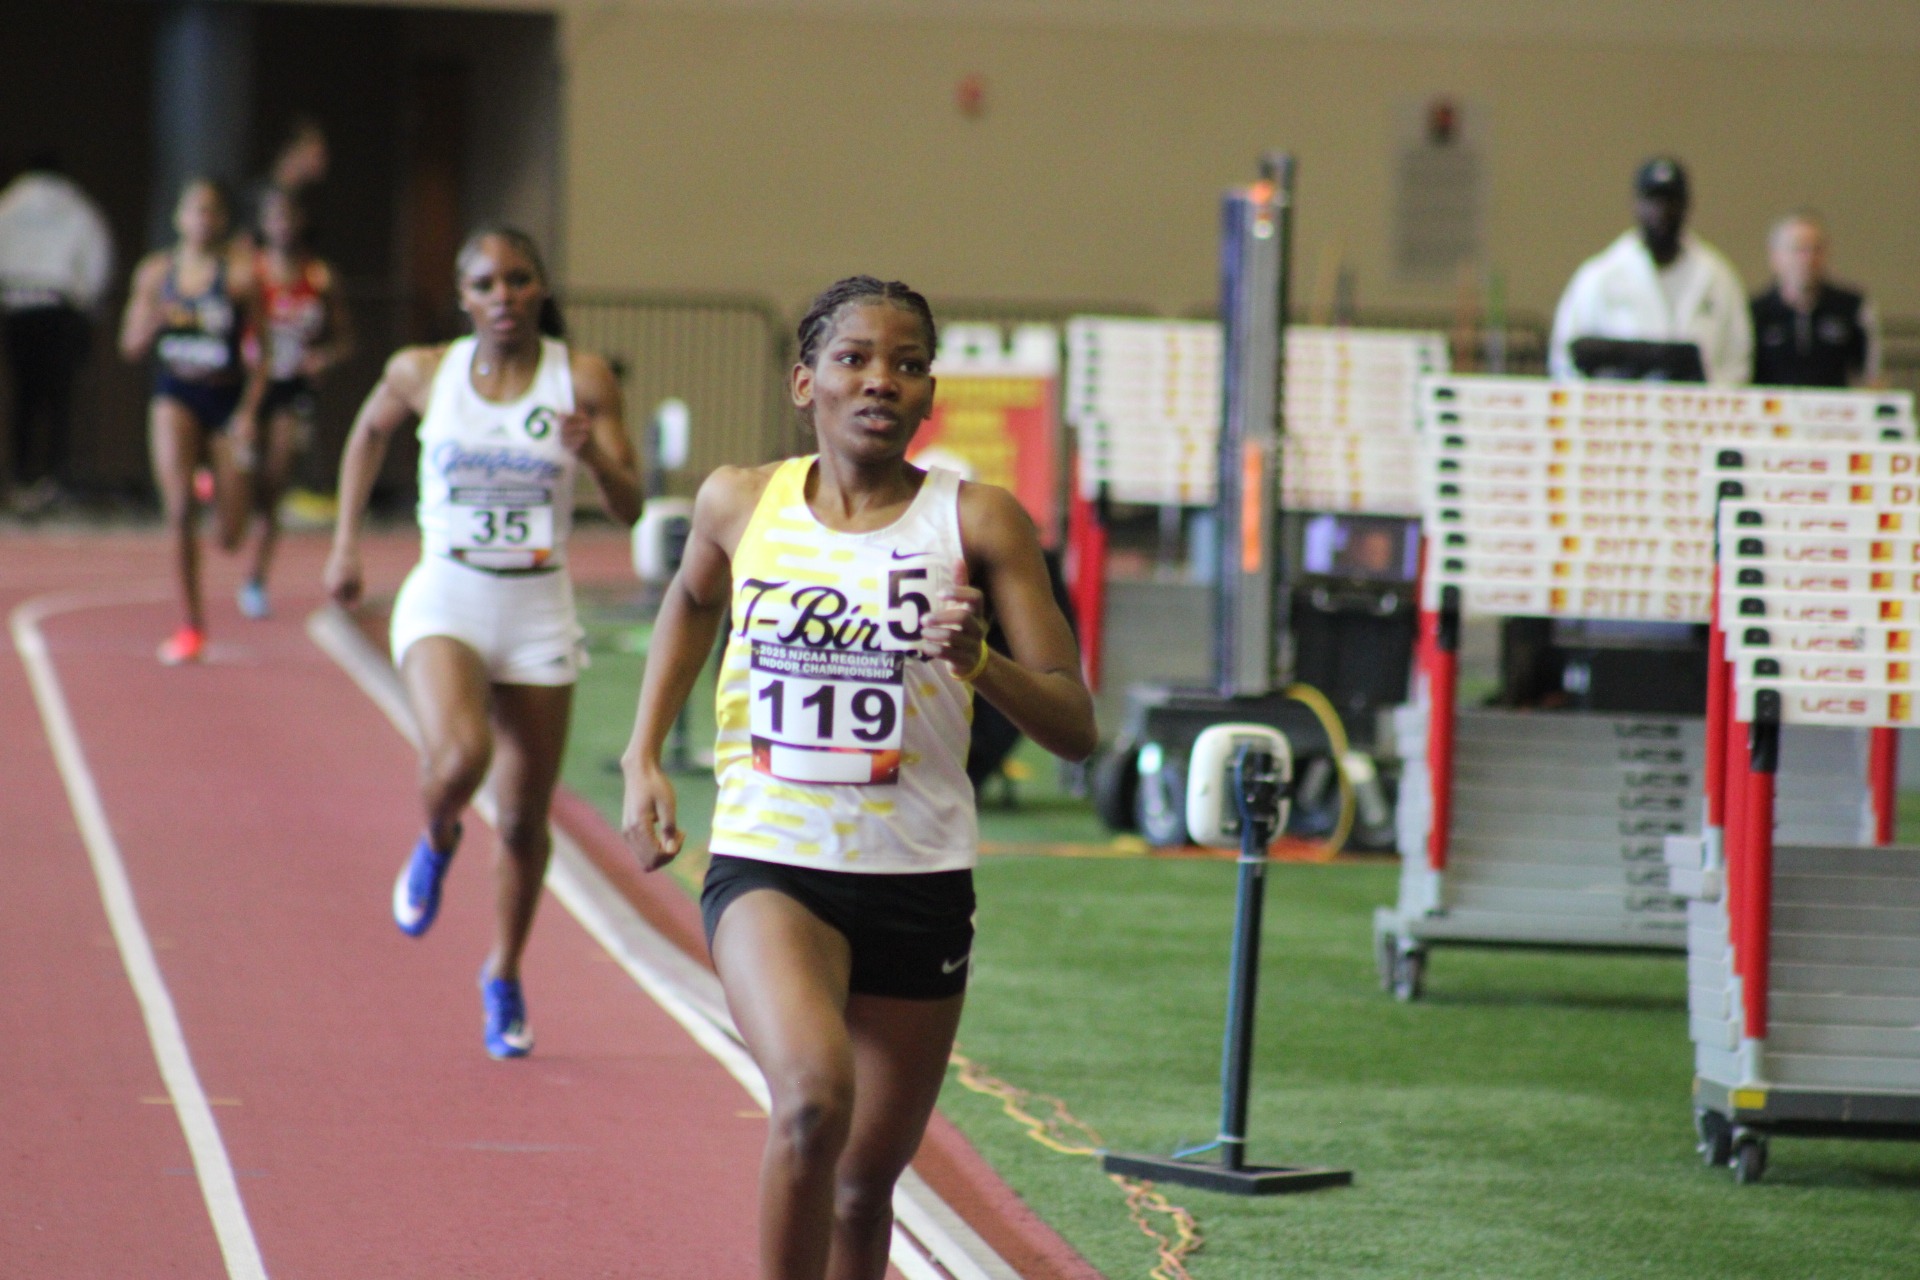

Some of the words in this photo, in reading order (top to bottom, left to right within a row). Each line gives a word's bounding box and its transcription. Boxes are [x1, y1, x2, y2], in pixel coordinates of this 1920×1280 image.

[525, 405, 556, 440] 6
[472, 509, 531, 545] 35
[739, 577, 884, 651] T-Bir
[887, 568, 932, 642] 5
[759, 656, 800, 672] INDOOR
[802, 663, 894, 679] CHAMPIONSHIP
[760, 644, 787, 659] 2025
[789, 649, 827, 663] NJCAA
[830, 653, 878, 667] REGION
[758, 679, 897, 743] 119
